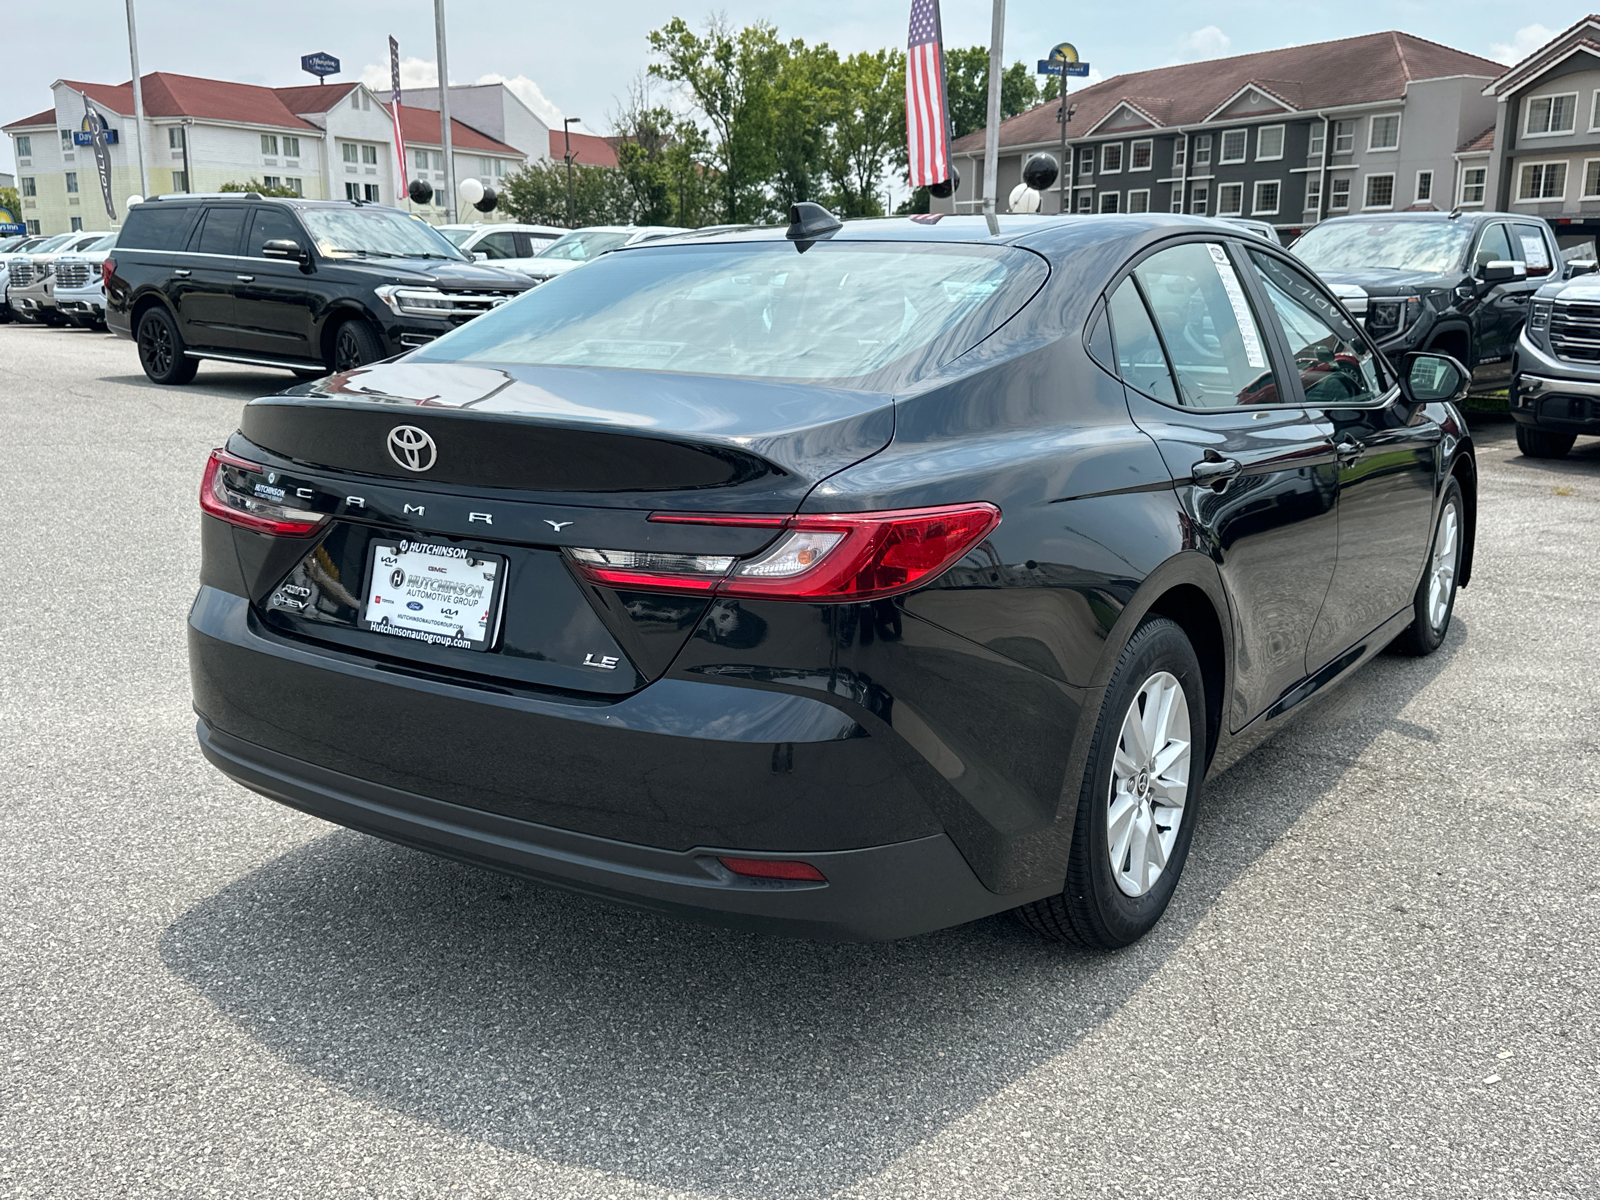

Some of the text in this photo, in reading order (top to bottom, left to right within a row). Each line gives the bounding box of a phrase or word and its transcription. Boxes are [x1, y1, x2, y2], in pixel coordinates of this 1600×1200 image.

[79, 133, 92, 142] Day
[254, 483, 286, 497] HUTCHINSON
[296, 487, 574, 532] CAMRY
[409, 541, 468, 559] HUTCHINSON
[428, 566, 447, 574] GMC
[406, 574, 485, 599] HUTCHINSON
[406, 589, 479, 608] AUTOMOTIVE GROUP
[397, 613, 464, 630] HUTCHINSONAUTOGROUP.COM
[370, 621, 471, 649] Hutchinsonautogroup.com
[583, 653, 620, 670] LE
